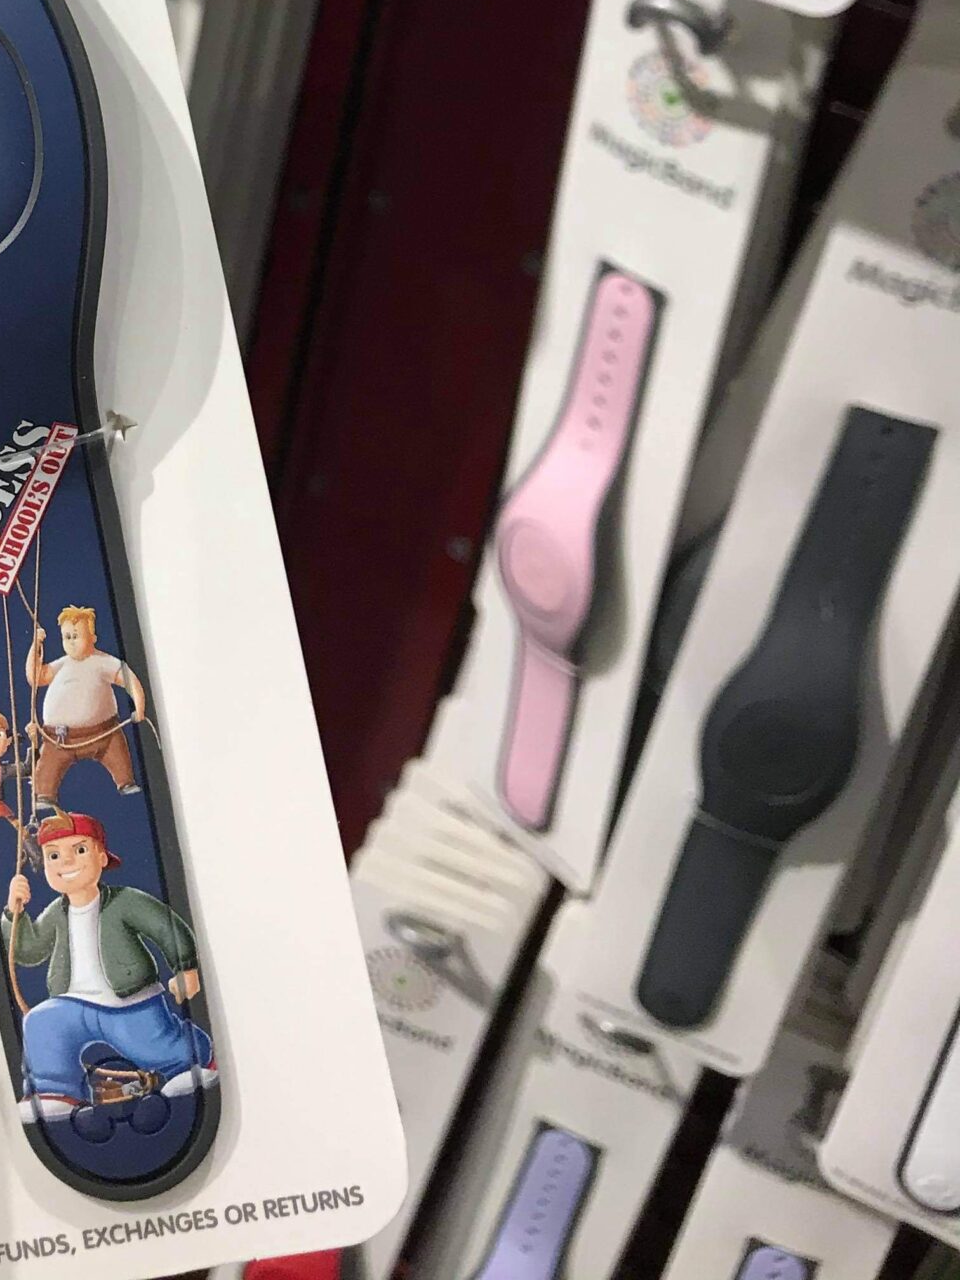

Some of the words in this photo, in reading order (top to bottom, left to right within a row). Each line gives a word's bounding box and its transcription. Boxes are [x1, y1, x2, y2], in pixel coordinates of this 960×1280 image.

[41, 428, 75, 475] OUT
[82, 1207, 219, 1251] EXCHANGES
[224, 1201, 259, 1227] OR
[263, 1185, 365, 1221] RETURNS
